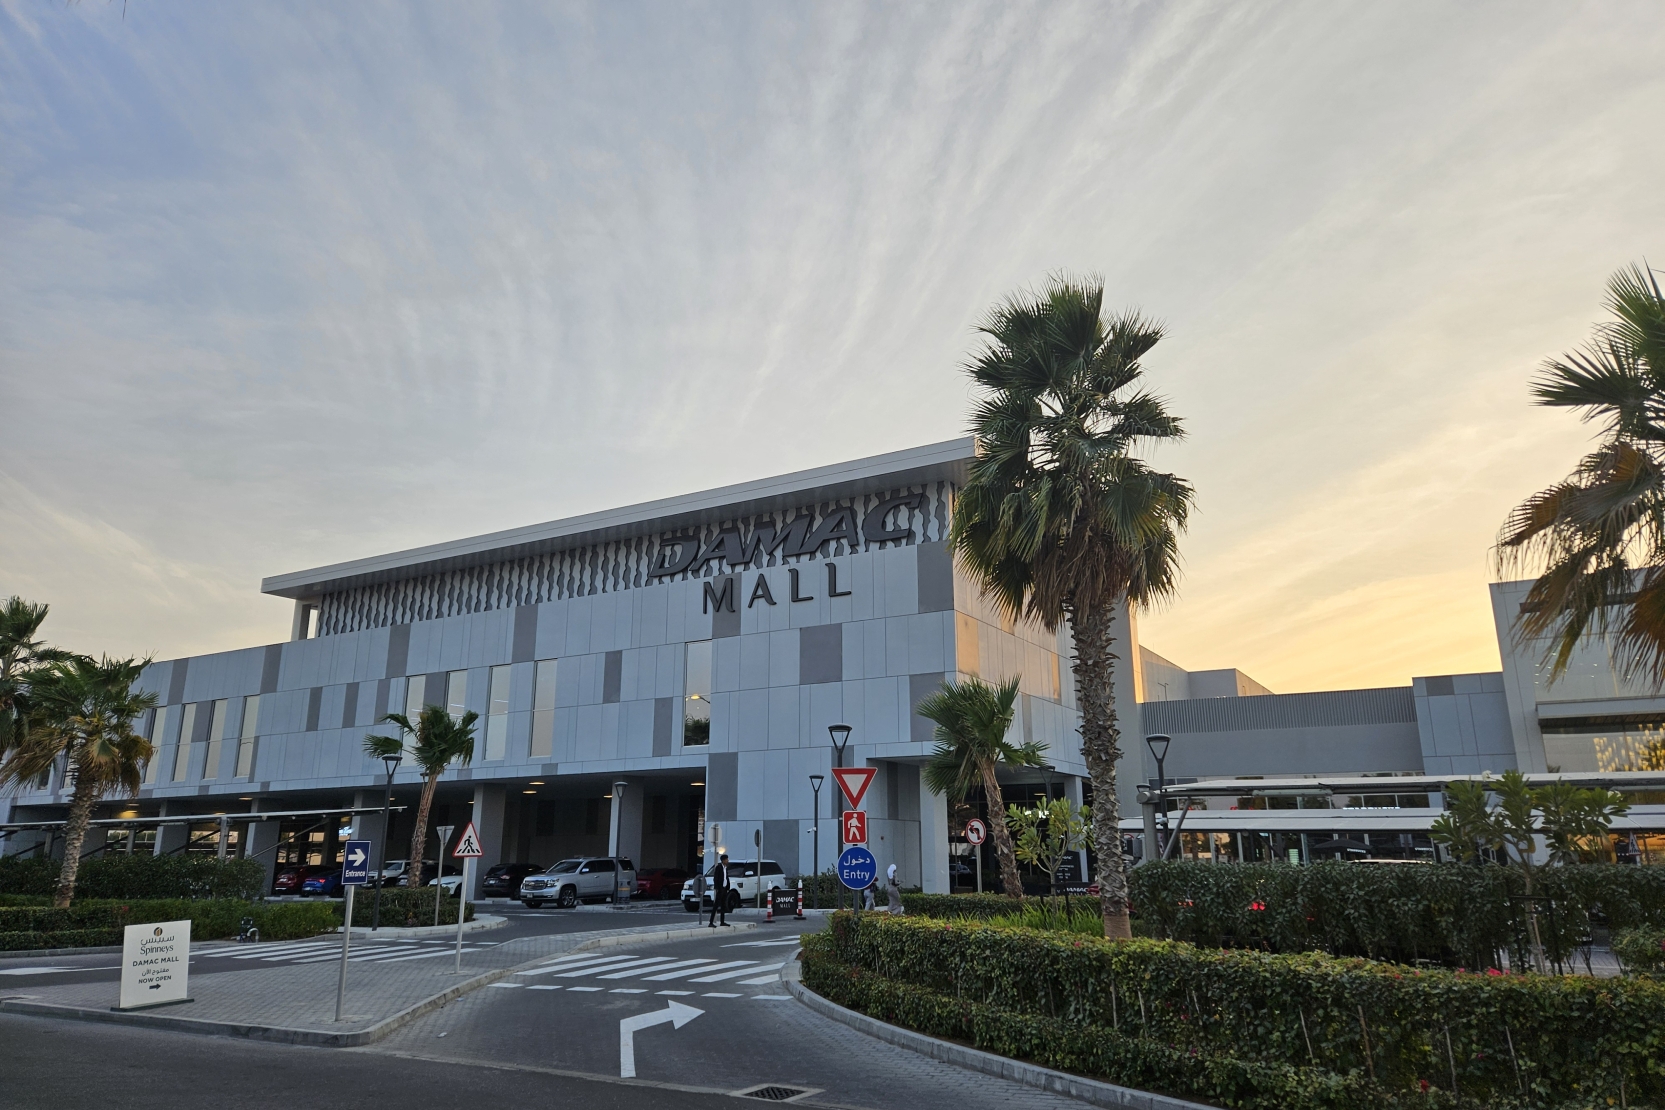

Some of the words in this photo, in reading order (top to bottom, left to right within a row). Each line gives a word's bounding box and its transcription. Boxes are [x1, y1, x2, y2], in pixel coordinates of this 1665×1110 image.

[649, 492, 924, 578] DAMAC
[702, 562, 852, 615] MALL
[843, 855, 871, 866] دخول
[345, 870, 366, 878] Entrance
[843, 870, 870, 881] Entry
[139, 944, 174, 957] Spinneys
[132, 958, 159, 967] DAMAC
[160, 956, 180, 964] MALL
[138, 977, 154, 985] NOW
[155, 975, 172, 983] OPEN
